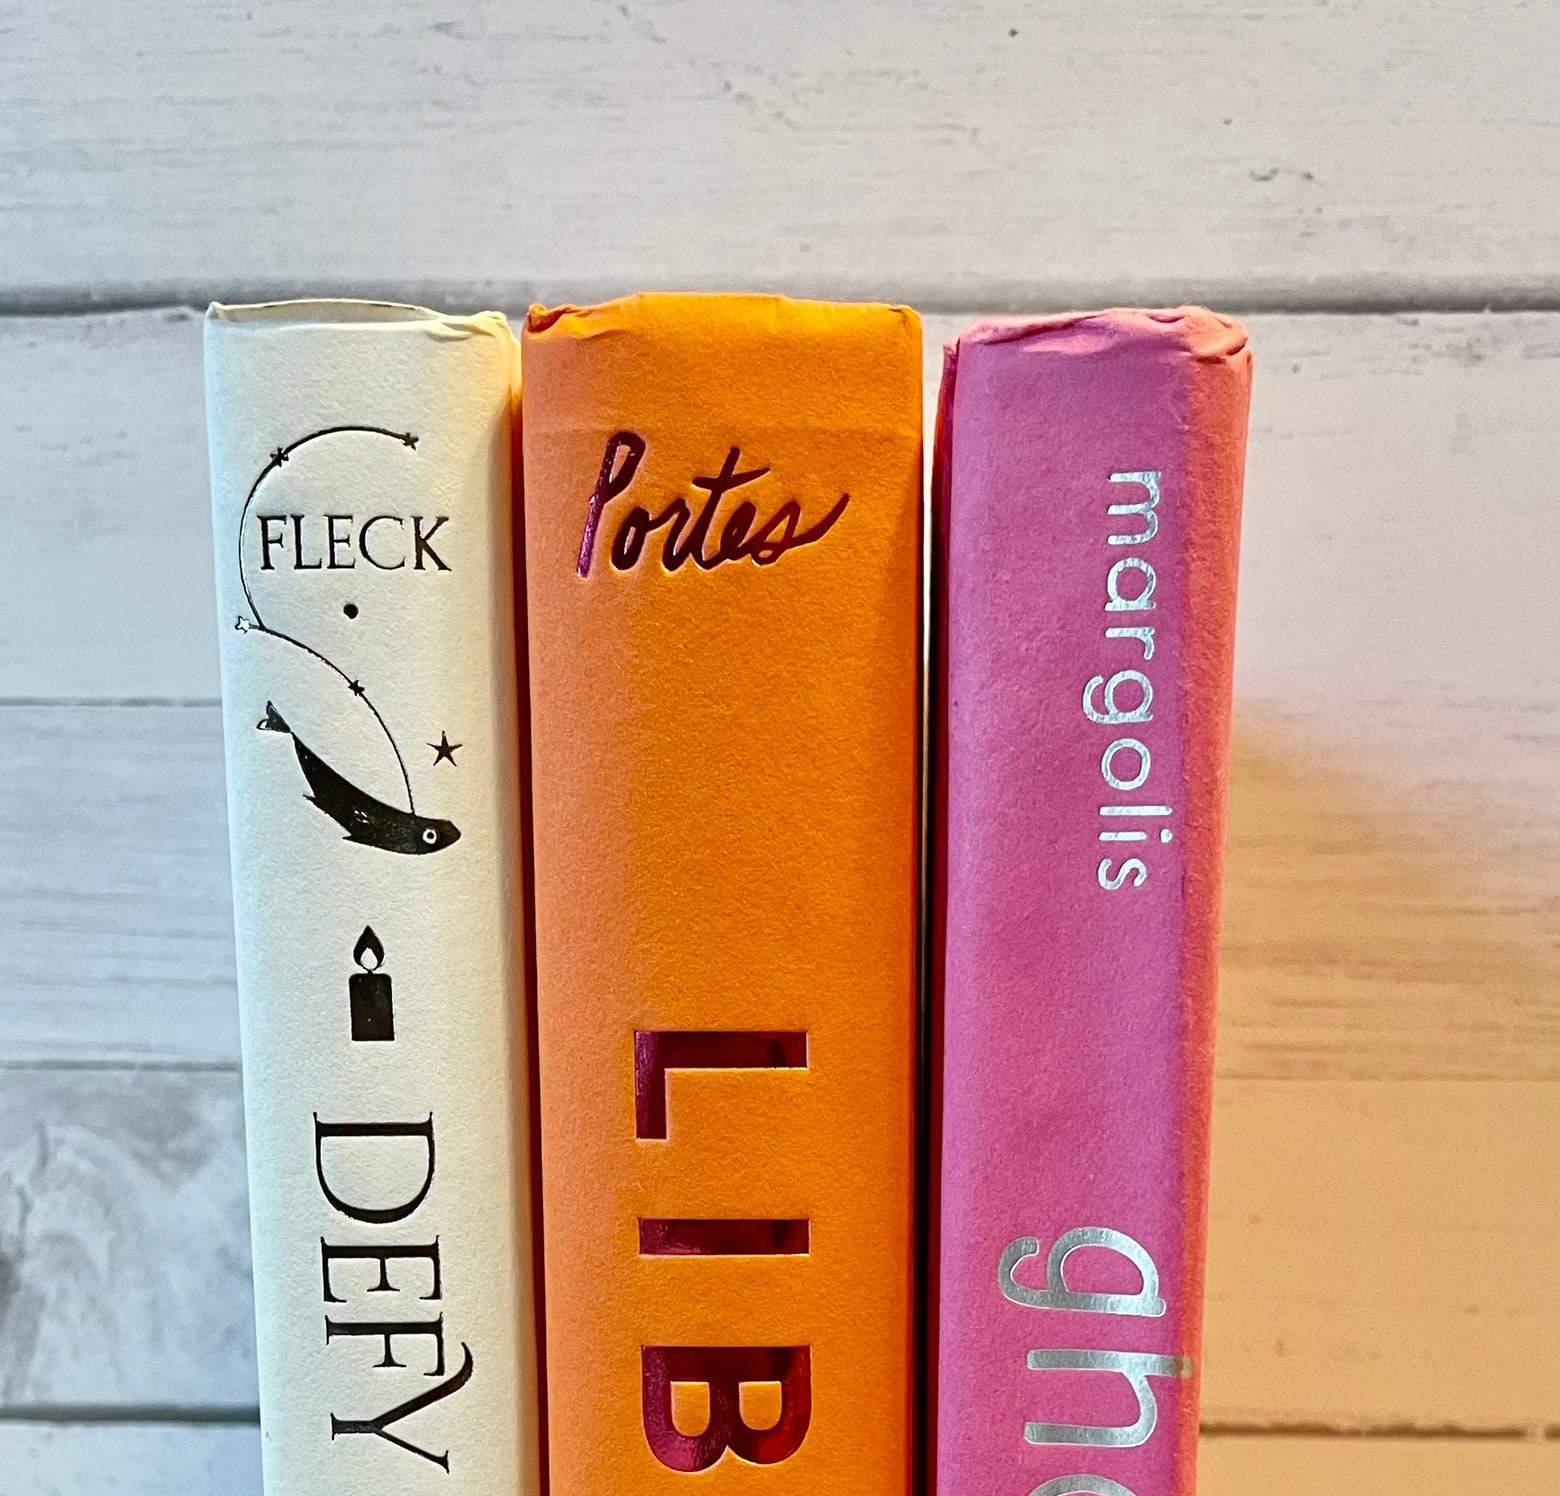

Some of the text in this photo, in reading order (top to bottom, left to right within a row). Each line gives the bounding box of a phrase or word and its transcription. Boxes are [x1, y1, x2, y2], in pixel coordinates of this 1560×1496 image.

[257, 514, 452, 572] FLECK
[576, 431, 850, 578] Portes
[1082, 470, 1173, 890] margolis
[313, 1111, 474, 1474] DEFY
